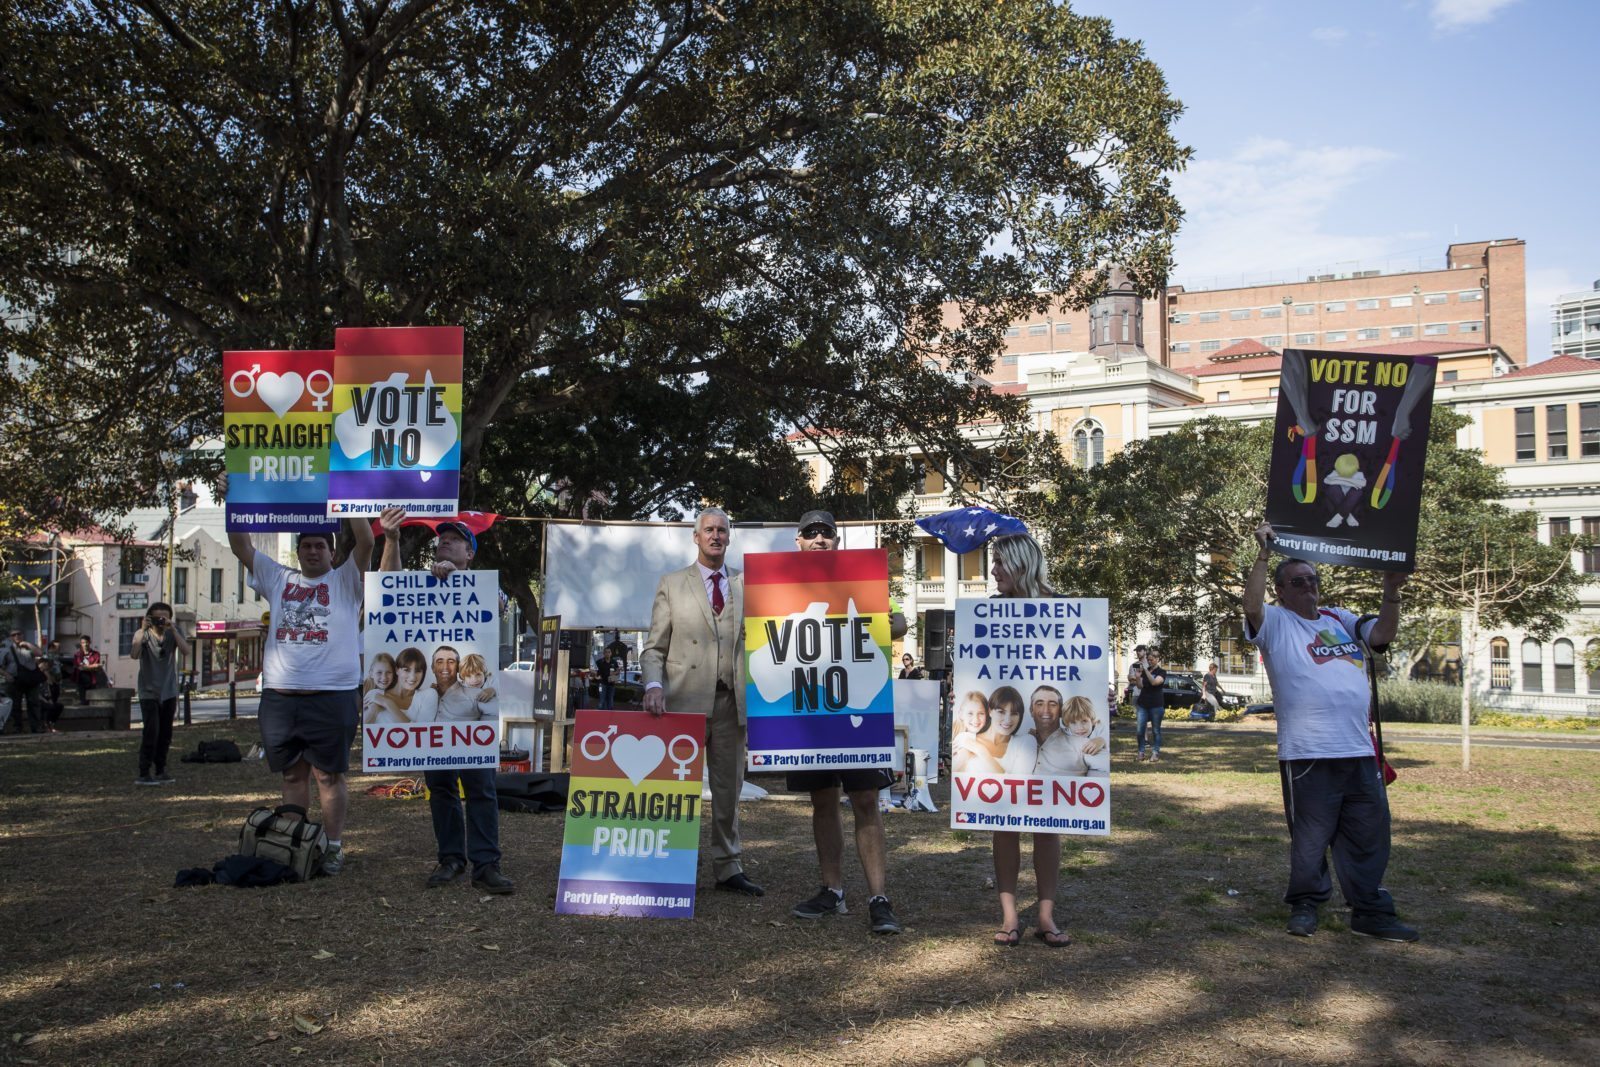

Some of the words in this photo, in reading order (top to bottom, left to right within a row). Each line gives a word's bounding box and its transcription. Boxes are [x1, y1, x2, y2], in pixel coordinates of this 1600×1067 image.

[1310, 358, 1370, 384] VOTE
[1374, 361, 1408, 387] NO
[351, 386, 446, 426] VOTE
[1332, 389, 1377, 416] FOR
[1324, 418, 1378, 444] SSM
[372, 428, 421, 468] NO
[250, 456, 315, 481] PRIDE
[350, 504, 373, 513] Party
[231, 513, 254, 523] Party
[256, 513, 268, 523] for
[1302, 541, 1318, 552] for
[1320, 542, 1406, 561] Freedom.org.au
[383, 593, 461, 606] DESERVE
[467, 592, 479, 605] A
[369, 611, 446, 625] MOTHER
[452, 610, 492, 624] AND
[974, 603, 1081, 618] CHILDREN
[386, 630, 398, 642] A
[405, 628, 475, 642] FATHER
[975, 624, 1064, 638] DESERVE
[1072, 624, 1086, 638] A
[764, 617, 874, 664] VOTE
[960, 644, 1046, 660] MOTHER
[1054, 644, 1102, 660] AND
[1312, 646, 1342, 656] VOE
[1341, 644, 1358, 653] NO
[978, 665, 992, 679] A
[1000, 665, 1081, 681] FATHER
[792, 666, 849, 713] NO
[366, 726, 444, 749] VOTE
[452, 725, 495, 746] NO
[388, 758, 411, 767] Party
[413, 757, 425, 766] for
[427, 756, 495, 765] Freedom.org.au
[774, 755, 799, 765] Party
[801, 754, 814, 764] for
[817, 753, 891, 764] Freedom.org.au
[955, 777, 1044, 805] VOTE
[1053, 780, 1105, 807] NO
[570, 790, 699, 822] STRAIGHT
[979, 814, 1005, 826] Party
[1007, 815, 1022, 825] for
[1024, 815, 1105, 830] Freedom.org.au
[592, 826, 670, 858] PRIDE
[564, 891, 592, 904] Party
[593, 892, 608, 904] for
[610, 893, 690, 908] Freedom.org.au
